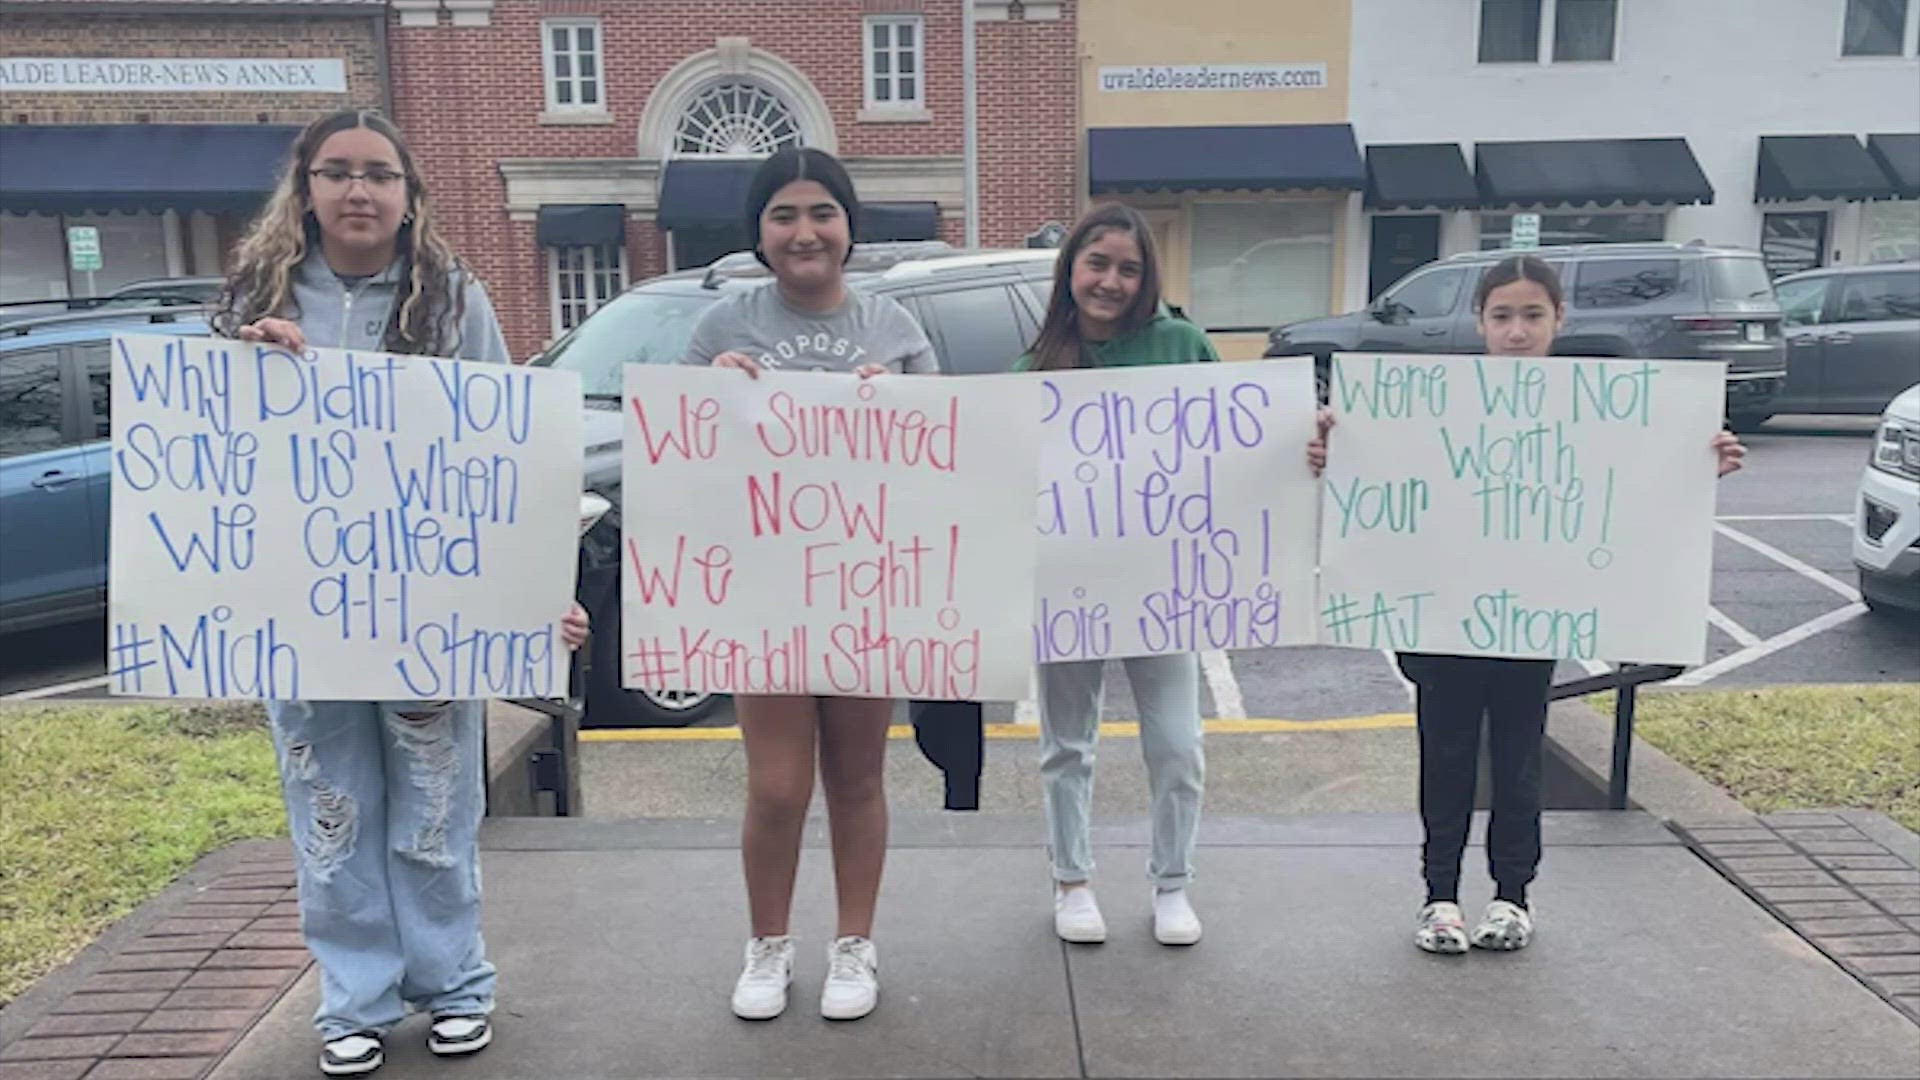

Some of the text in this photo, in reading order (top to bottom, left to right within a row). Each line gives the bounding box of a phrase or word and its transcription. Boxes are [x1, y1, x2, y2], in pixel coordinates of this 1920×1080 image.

[62, 63, 229, 85] LEADER-NEWS
[235, 65, 316, 86] ANNEX
[1103, 67, 1321, 89] uvaldeleadernews.com
[117, 338, 230, 436] Why
[1334, 357, 1446, 419] Were
[1475, 359, 1546, 418] We
[116, 423, 258, 496] Save
[632, 383, 958, 472] We Survived
[1440, 421, 1575, 485] Worth
[149, 503, 257, 573] We
[629, 535, 733, 607] We
[395, 613, 553, 698] Strong
[628, 606, 980, 700] #Kendall Strong
[1321, 592, 1435, 650] #AJ
